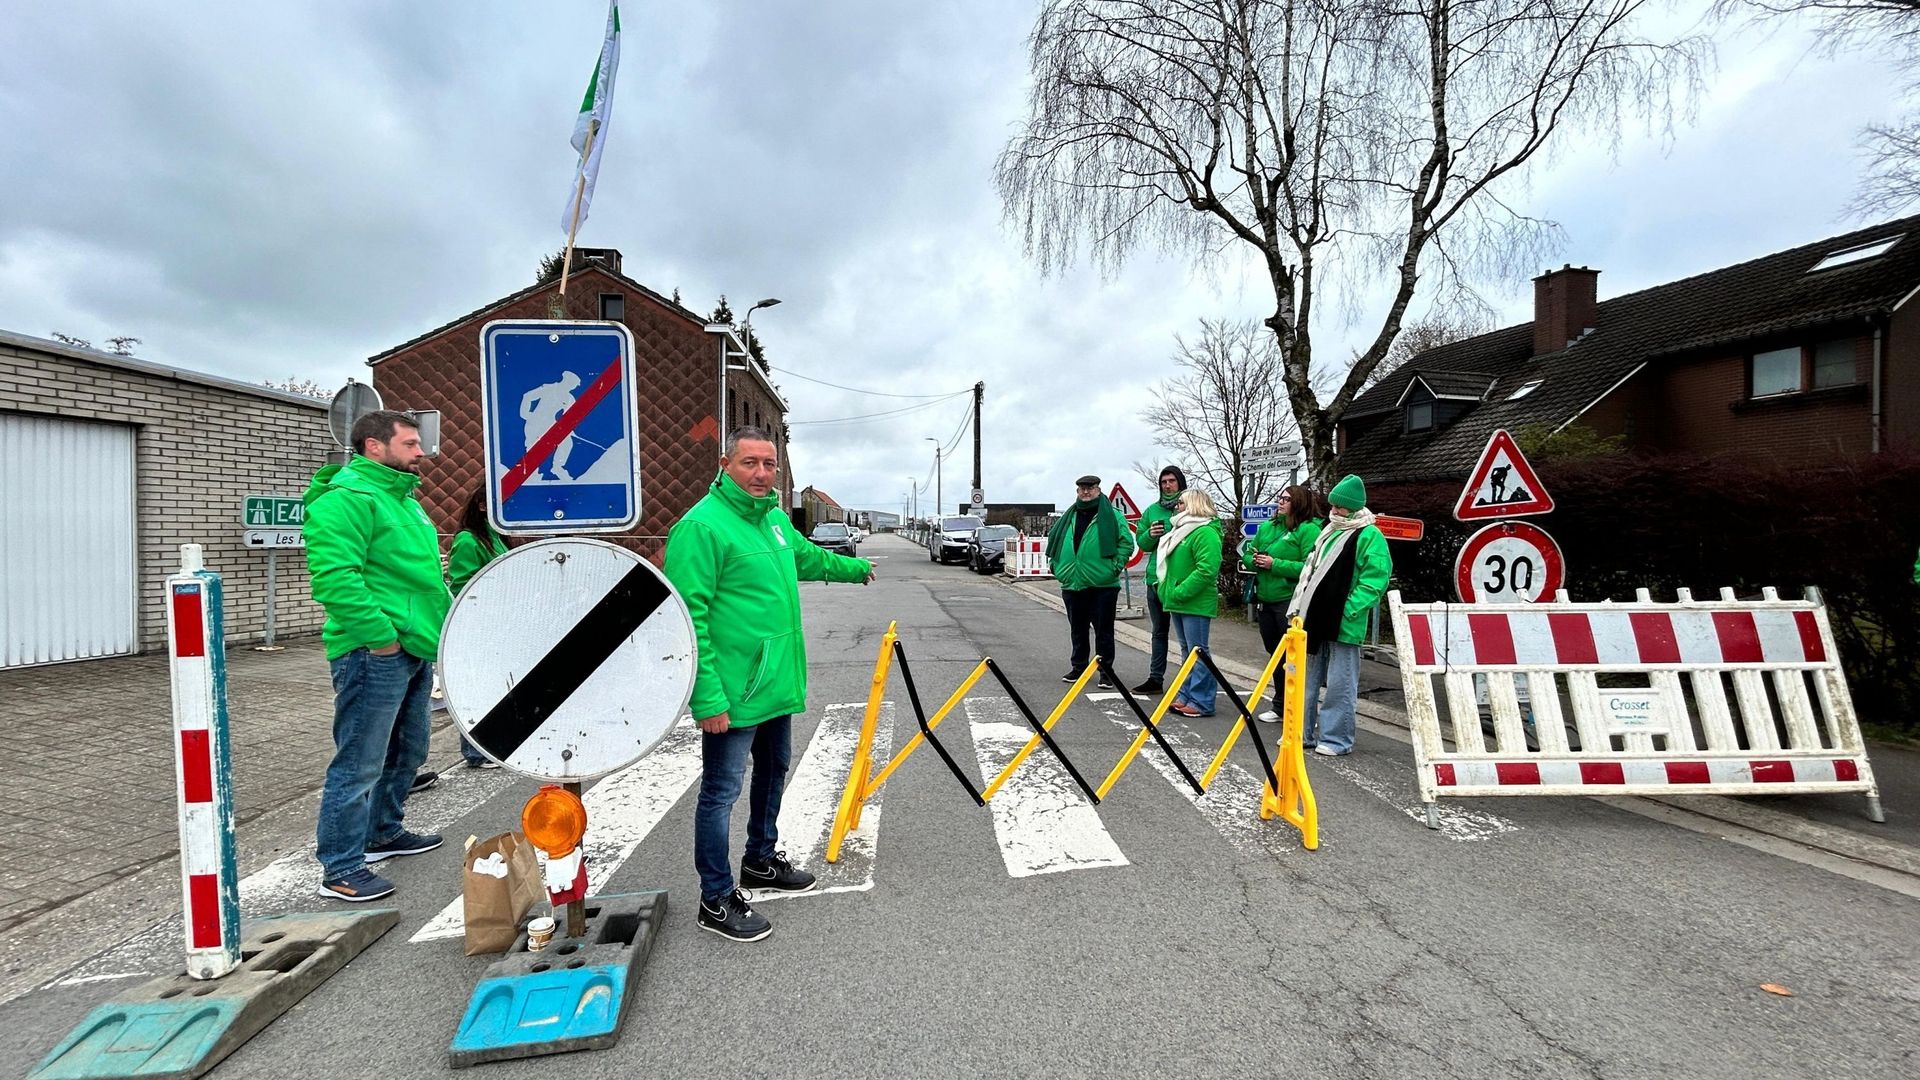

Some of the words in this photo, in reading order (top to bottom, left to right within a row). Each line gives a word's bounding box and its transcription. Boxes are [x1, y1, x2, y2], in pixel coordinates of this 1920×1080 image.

[275, 533, 294, 544] Les
[1484, 554, 1533, 594] 30
[1610, 698, 1649, 710] Crosset
